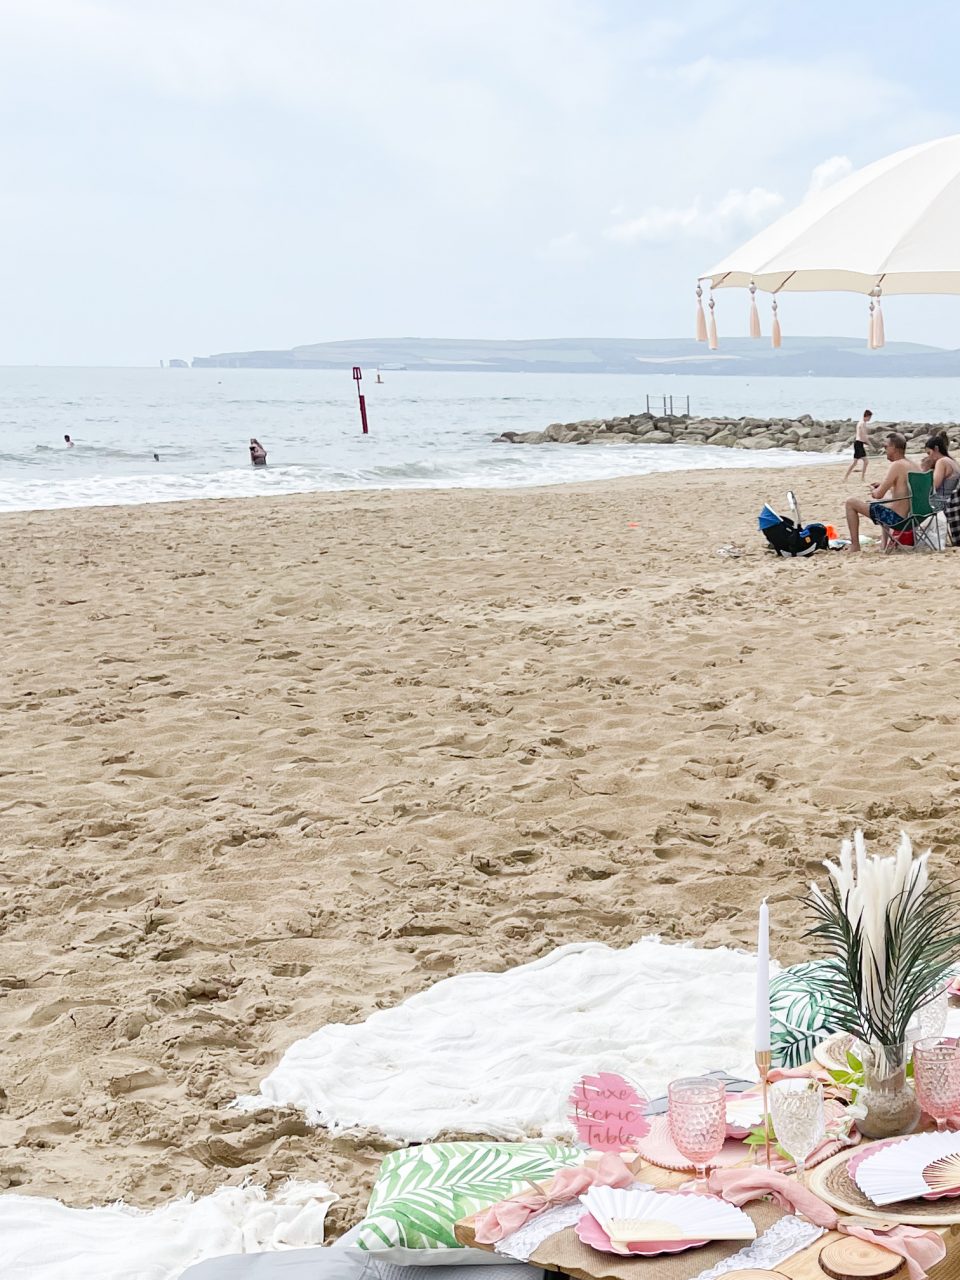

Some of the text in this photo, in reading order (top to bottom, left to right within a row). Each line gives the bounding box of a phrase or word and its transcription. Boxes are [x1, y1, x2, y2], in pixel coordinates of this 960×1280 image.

[582, 1080, 631, 1100] Luxe
[575, 1100, 638, 1123] Picnic
[580, 1124, 638, 1145] Table
